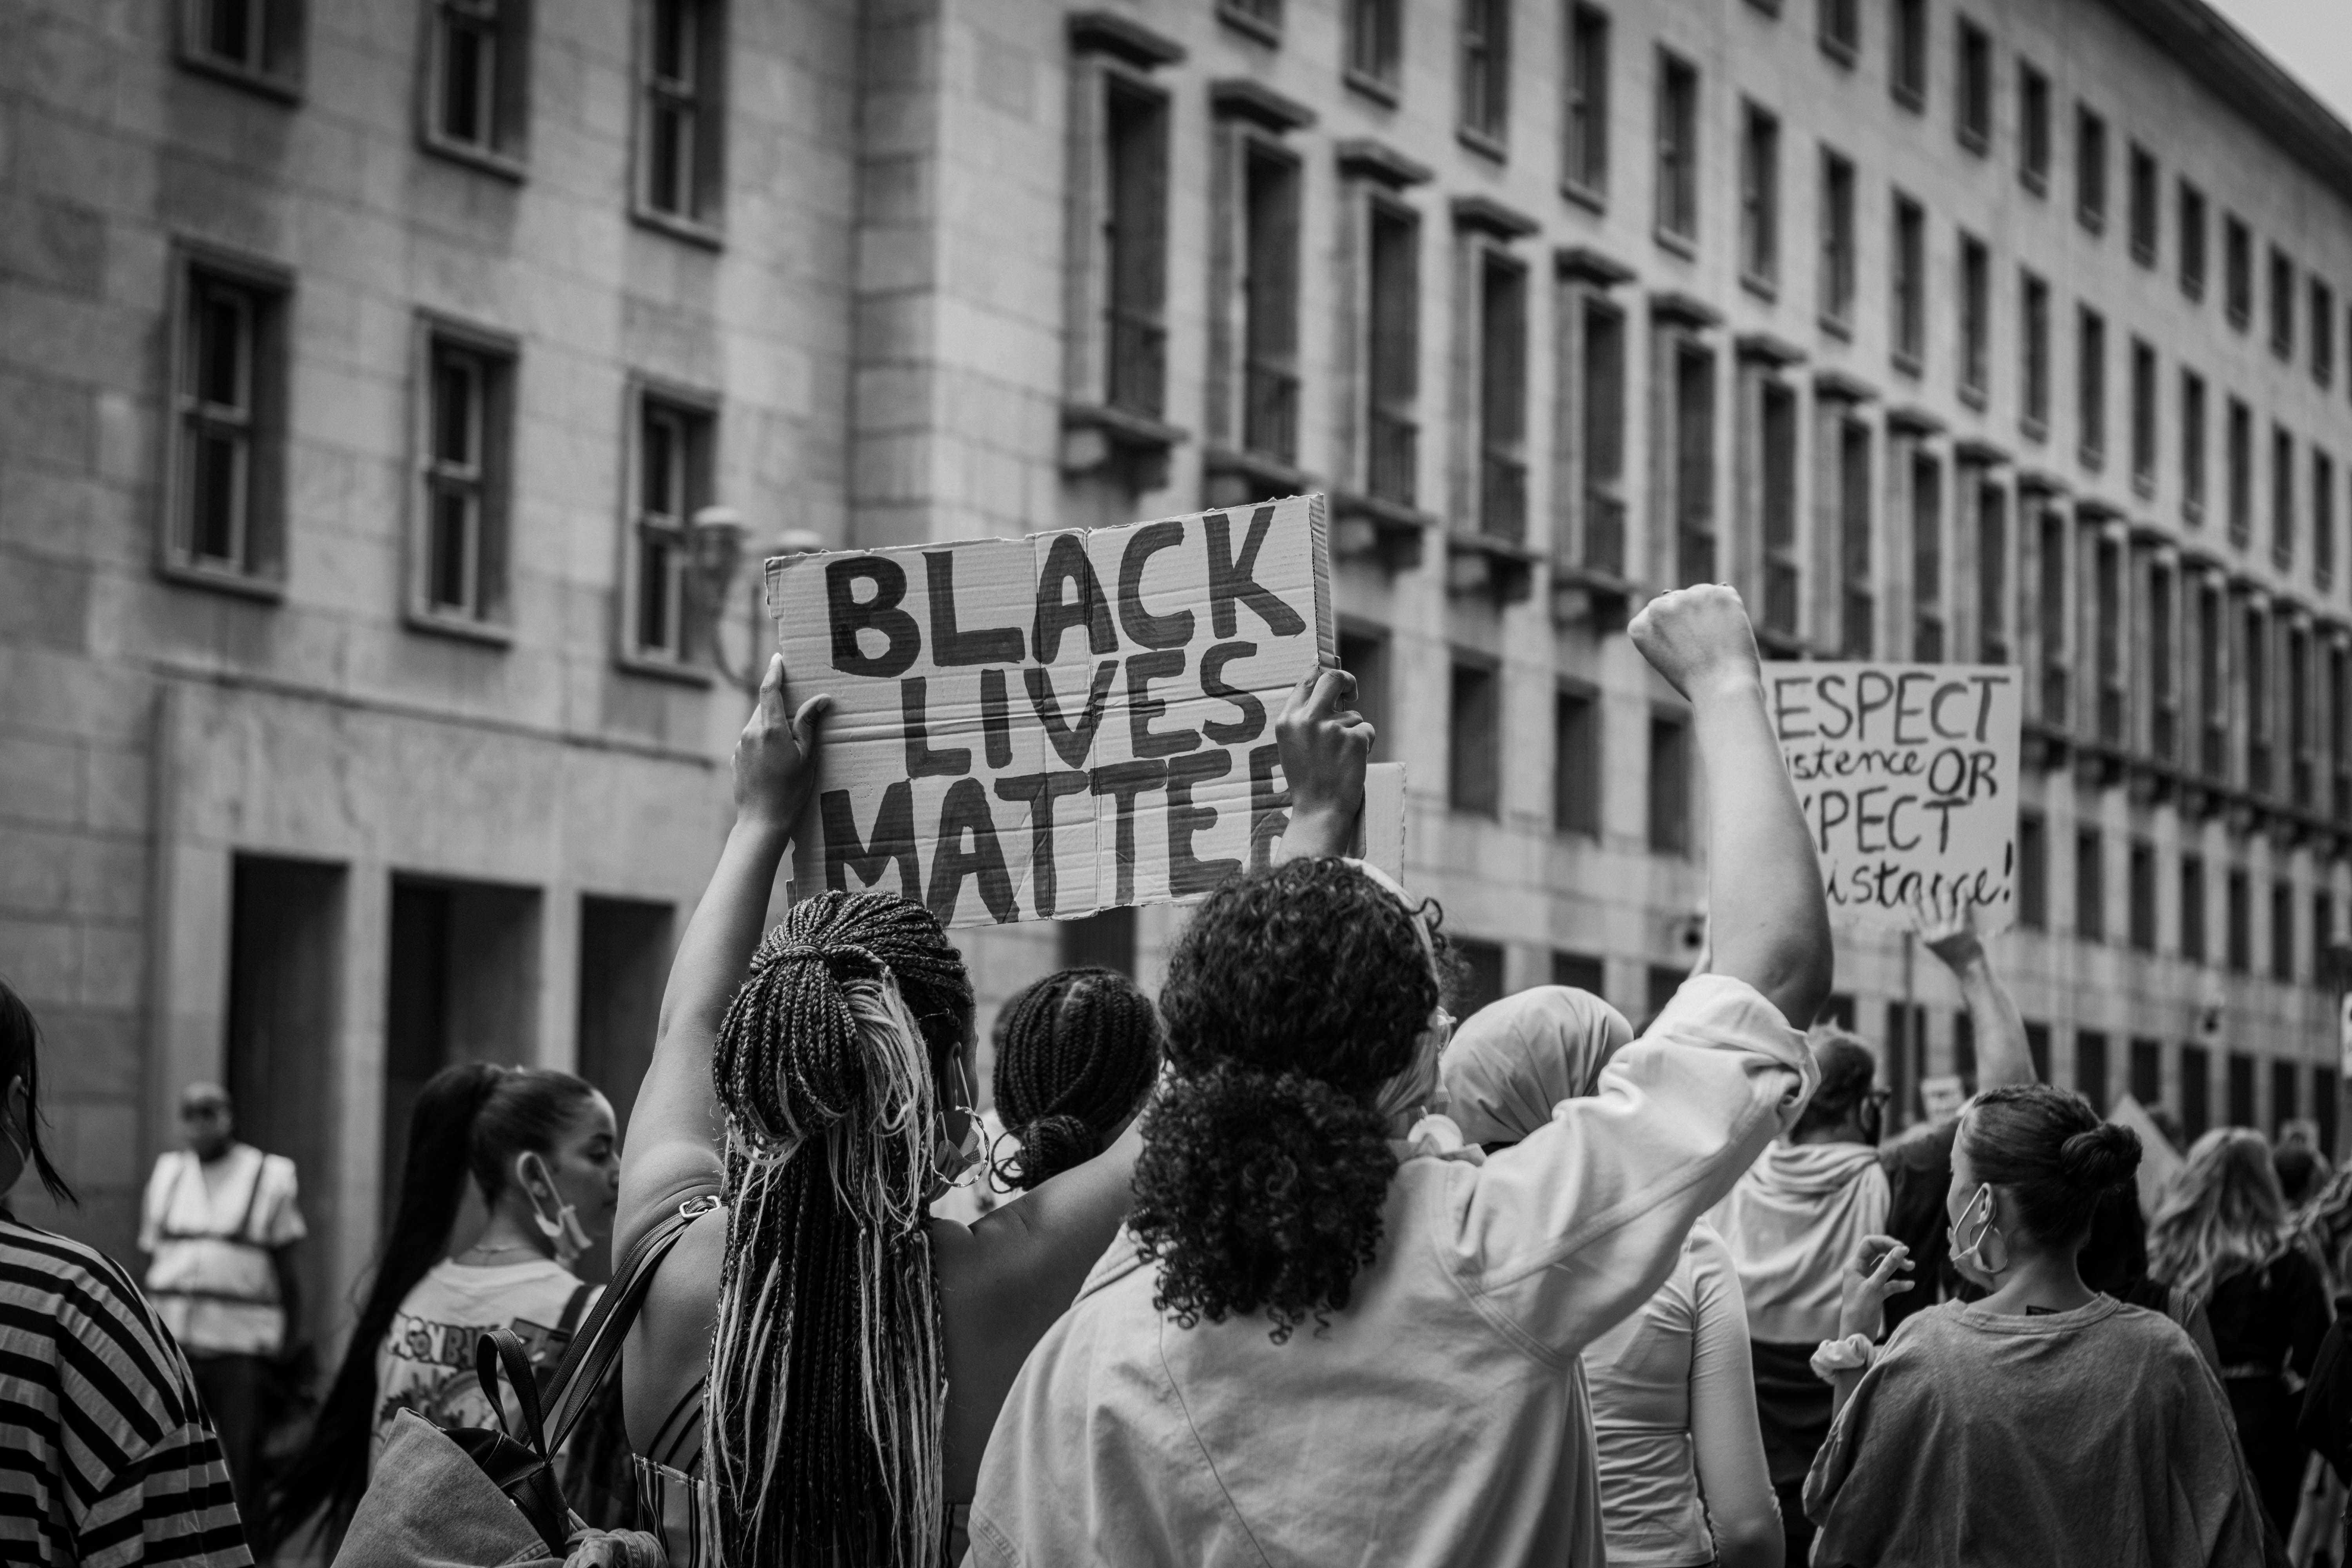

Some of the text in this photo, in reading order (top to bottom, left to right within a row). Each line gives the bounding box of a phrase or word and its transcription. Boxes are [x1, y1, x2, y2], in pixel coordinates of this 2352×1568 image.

[824, 506, 1307, 678] BLACK
[901, 641, 1267, 779] LIVES
[1804, 785, 1969, 854] PECT
[1929, 747, 1998, 799] OR
